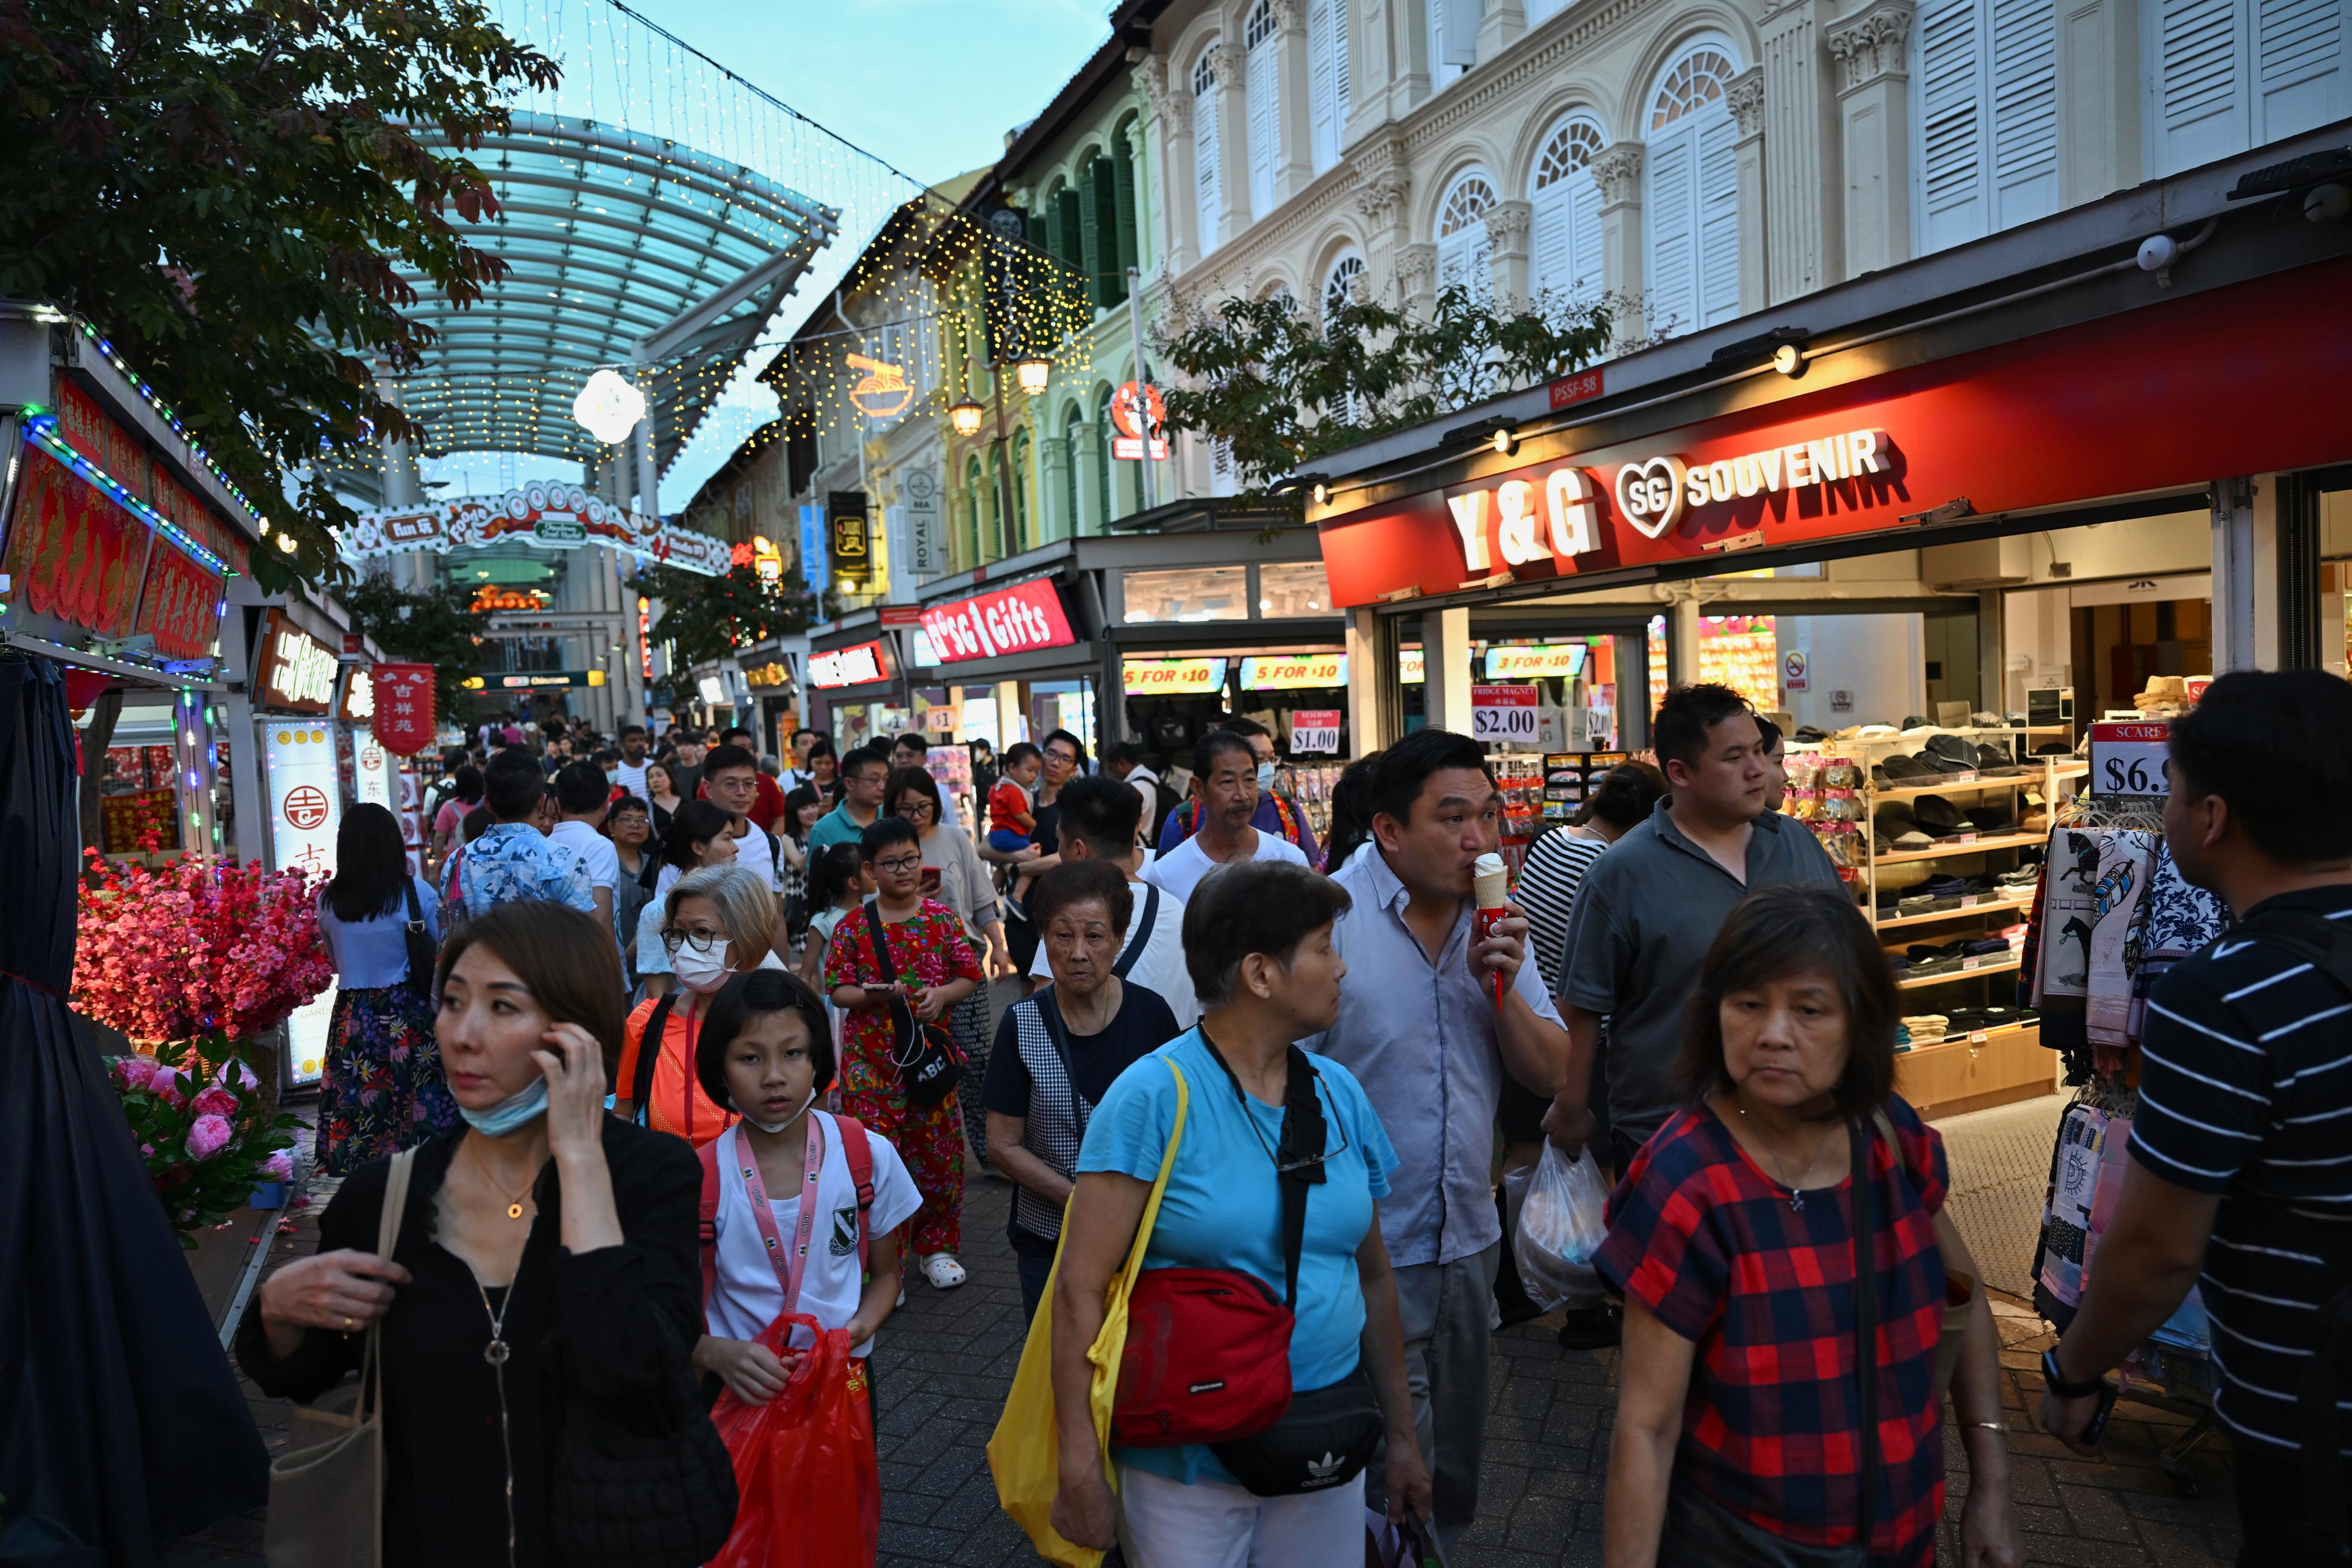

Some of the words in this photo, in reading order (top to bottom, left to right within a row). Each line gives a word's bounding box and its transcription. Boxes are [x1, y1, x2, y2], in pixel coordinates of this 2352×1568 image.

[1555, 376, 1596, 402] PSSF-58
[1448, 469, 1601, 571] Y&G
[1629, 480, 1665, 516] SG
[1686, 429, 1890, 507] SOUVENIR
[916, 520, 927, 567] ROYAL
[986, 596, 1050, 649] Gifts
[1257, 667, 1267, 678] 5
[1273, 666, 1307, 678] FOR
[1312, 665, 1337, 677] $10
[1499, 657, 1508, 668] 3
[1514, 657, 1544, 667] FOR
[1548, 656, 1569, 666] $10
[1124, 671, 1134, 684] 5
[1141, 670, 1177, 683] FOR
[1182, 669, 1209, 681] $10
[392, 684, 414, 733] 吉祥苑
[936, 713, 949, 727] $1
[1475, 710, 1534, 734] $2.00
[1294, 730, 1336, 748] $1.00
[2117, 726, 2162, 738] SCARF
[753, 1186, 765, 1208] DAISY
[800, 1213, 810, 1236] DAISY
[1301, 1475, 1340, 1487] adidas
